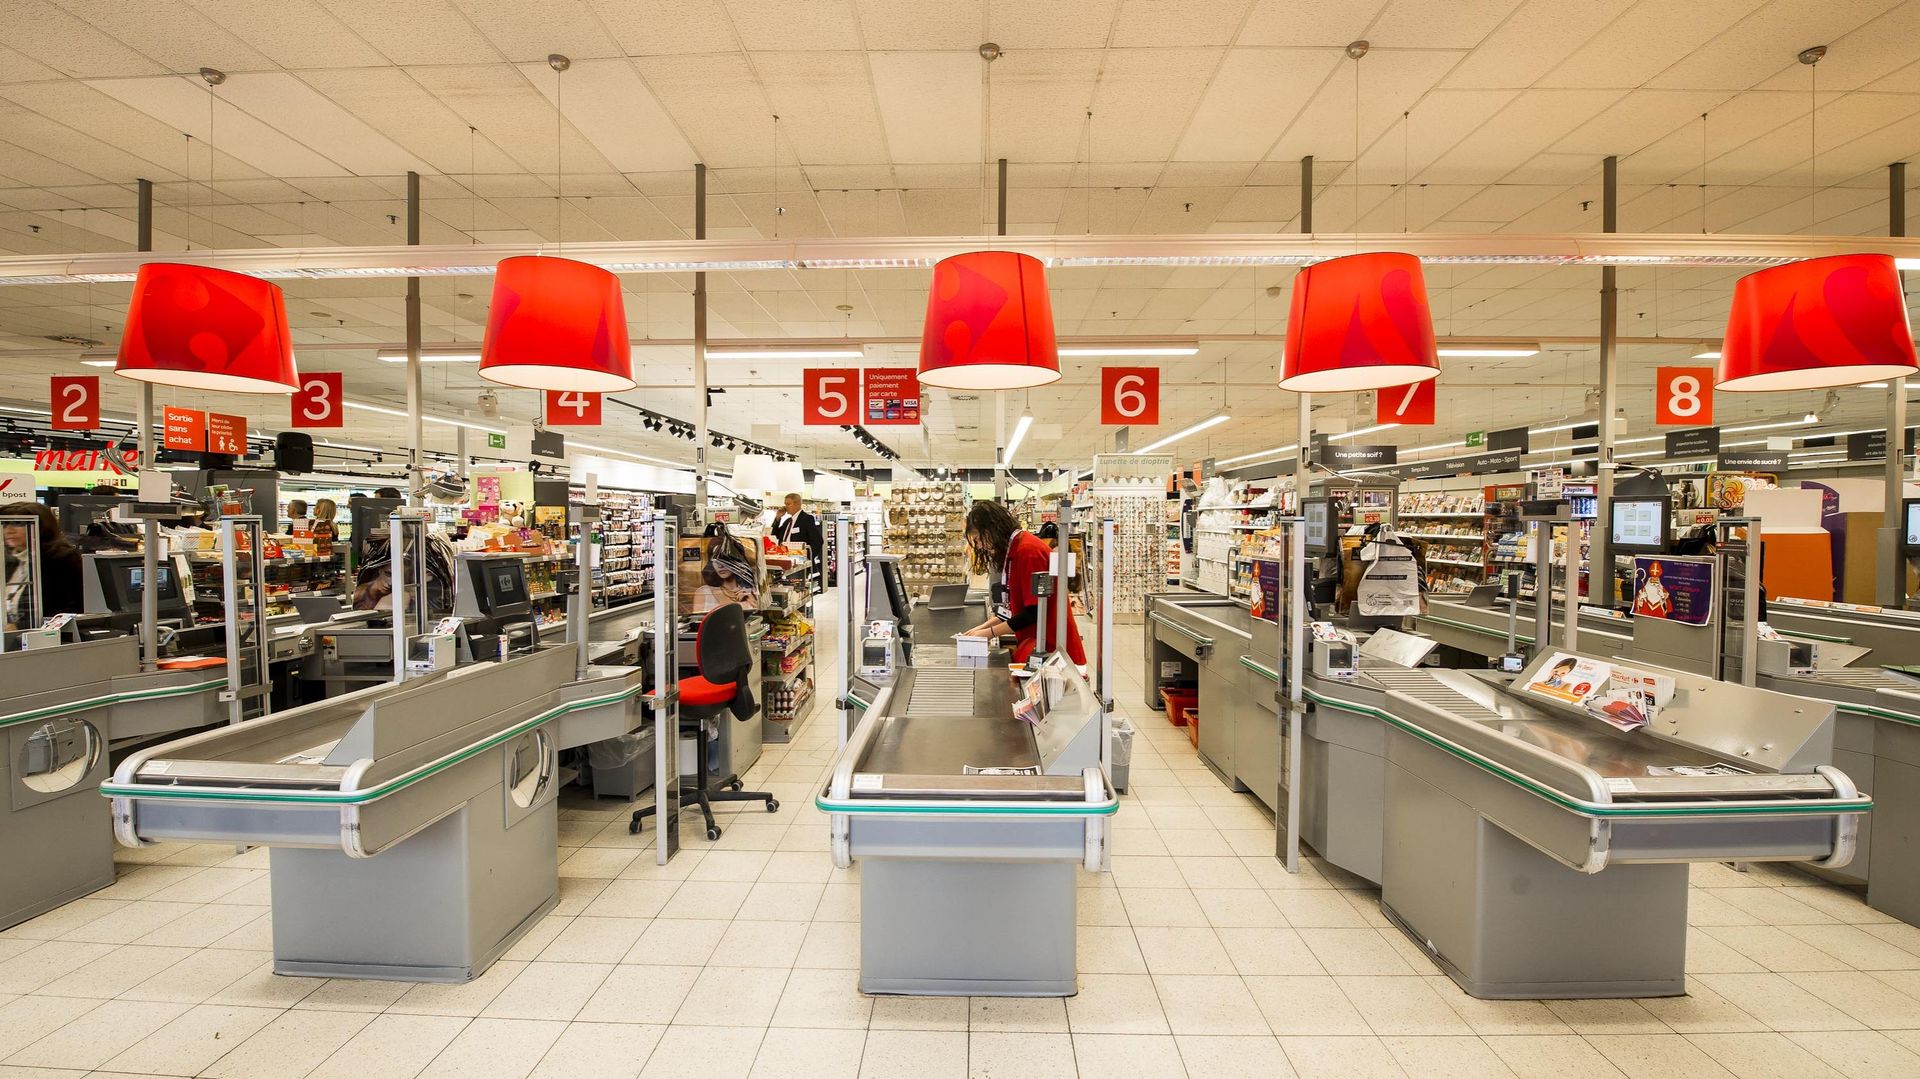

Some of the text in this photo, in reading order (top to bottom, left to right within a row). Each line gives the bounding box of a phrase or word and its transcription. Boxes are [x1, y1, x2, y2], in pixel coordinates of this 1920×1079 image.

[62, 383, 88, 423] 2
[303, 380, 331, 420] 3
[557, 391, 591, 417] 4
[817, 377, 848, 418] 5
[1114, 375, 1146, 417] 6
[1668, 375, 1701, 417] 8
[168, 412, 193, 423] Sortie
[168, 425, 188, 433] sans
[168, 436, 193, 444] achat
[34, 441, 138, 475] marke
[1141, 458, 1169, 466] dioptrie
[1348, 451, 1366, 459] petite
[1504, 455, 1518, 463] Sport
